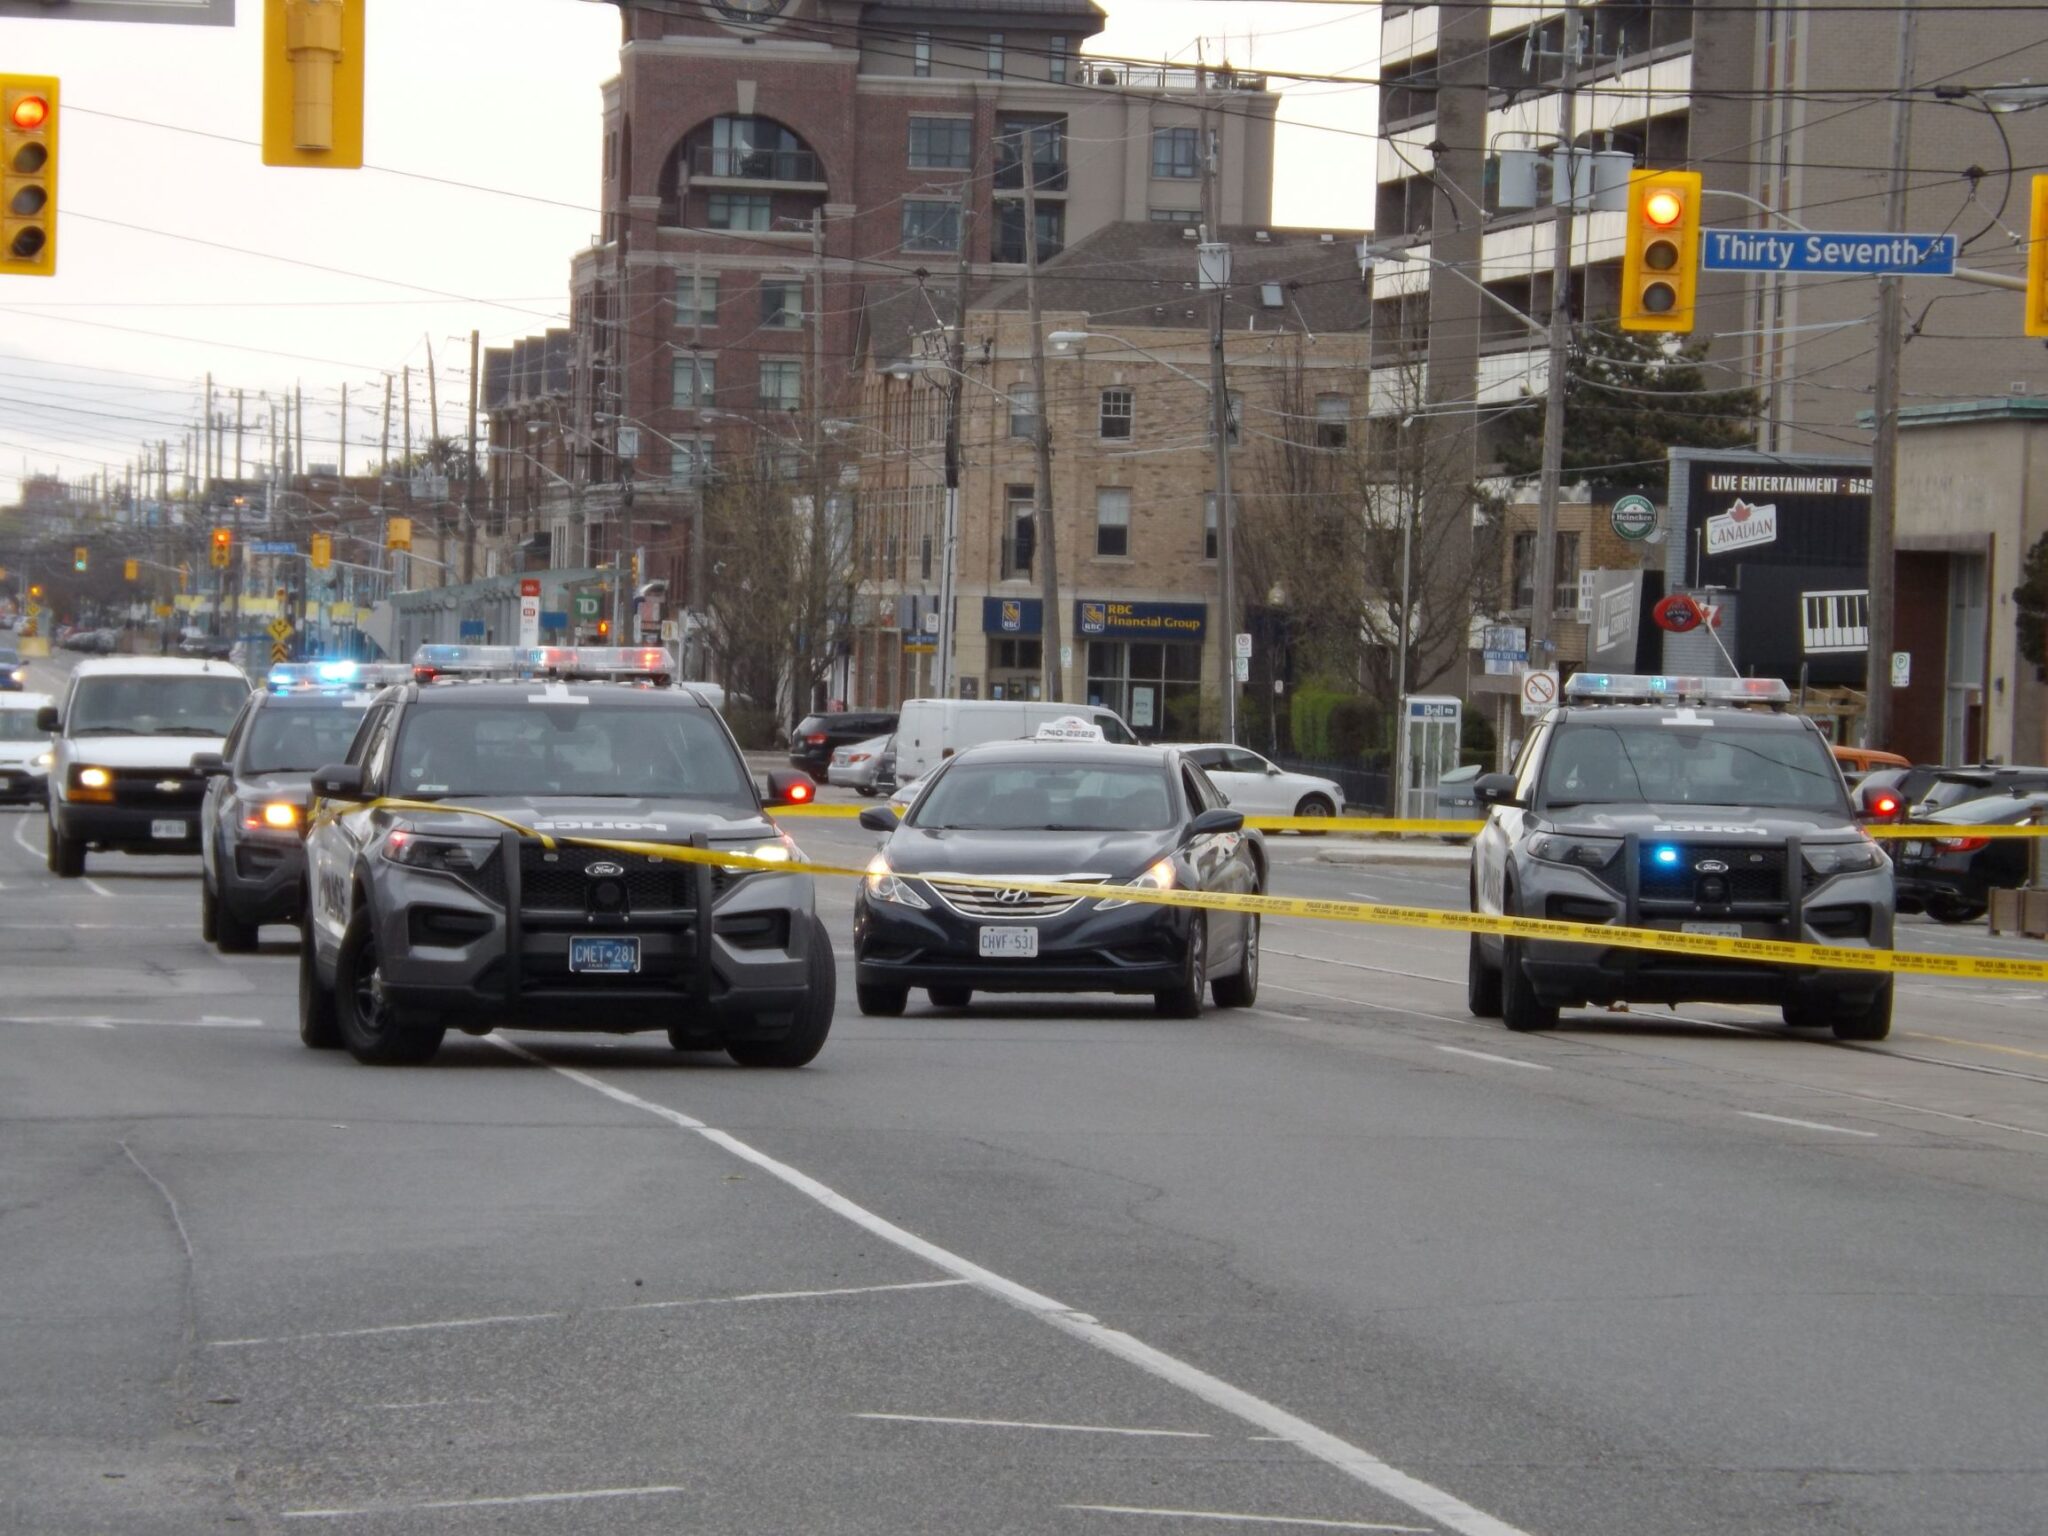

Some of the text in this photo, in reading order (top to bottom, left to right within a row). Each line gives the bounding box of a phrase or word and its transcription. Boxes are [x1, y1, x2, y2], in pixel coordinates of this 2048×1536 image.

[1716, 234, 1945, 268] Thirty Seventh St
[1711, 475, 1738, 490] LIVE
[1741, 476, 1838, 493] ENTERTAINMENT
[1616, 512, 1653, 521] Heineken
[1711, 518, 1774, 546] CANADIAN
[576, 598, 598, 613] TD
[1108, 604, 1132, 614] RBC
[1107, 616, 1200, 631] Financial Group
[982, 935, 1034, 950] CHVF 531
[575, 945, 636, 963] CMET 281
